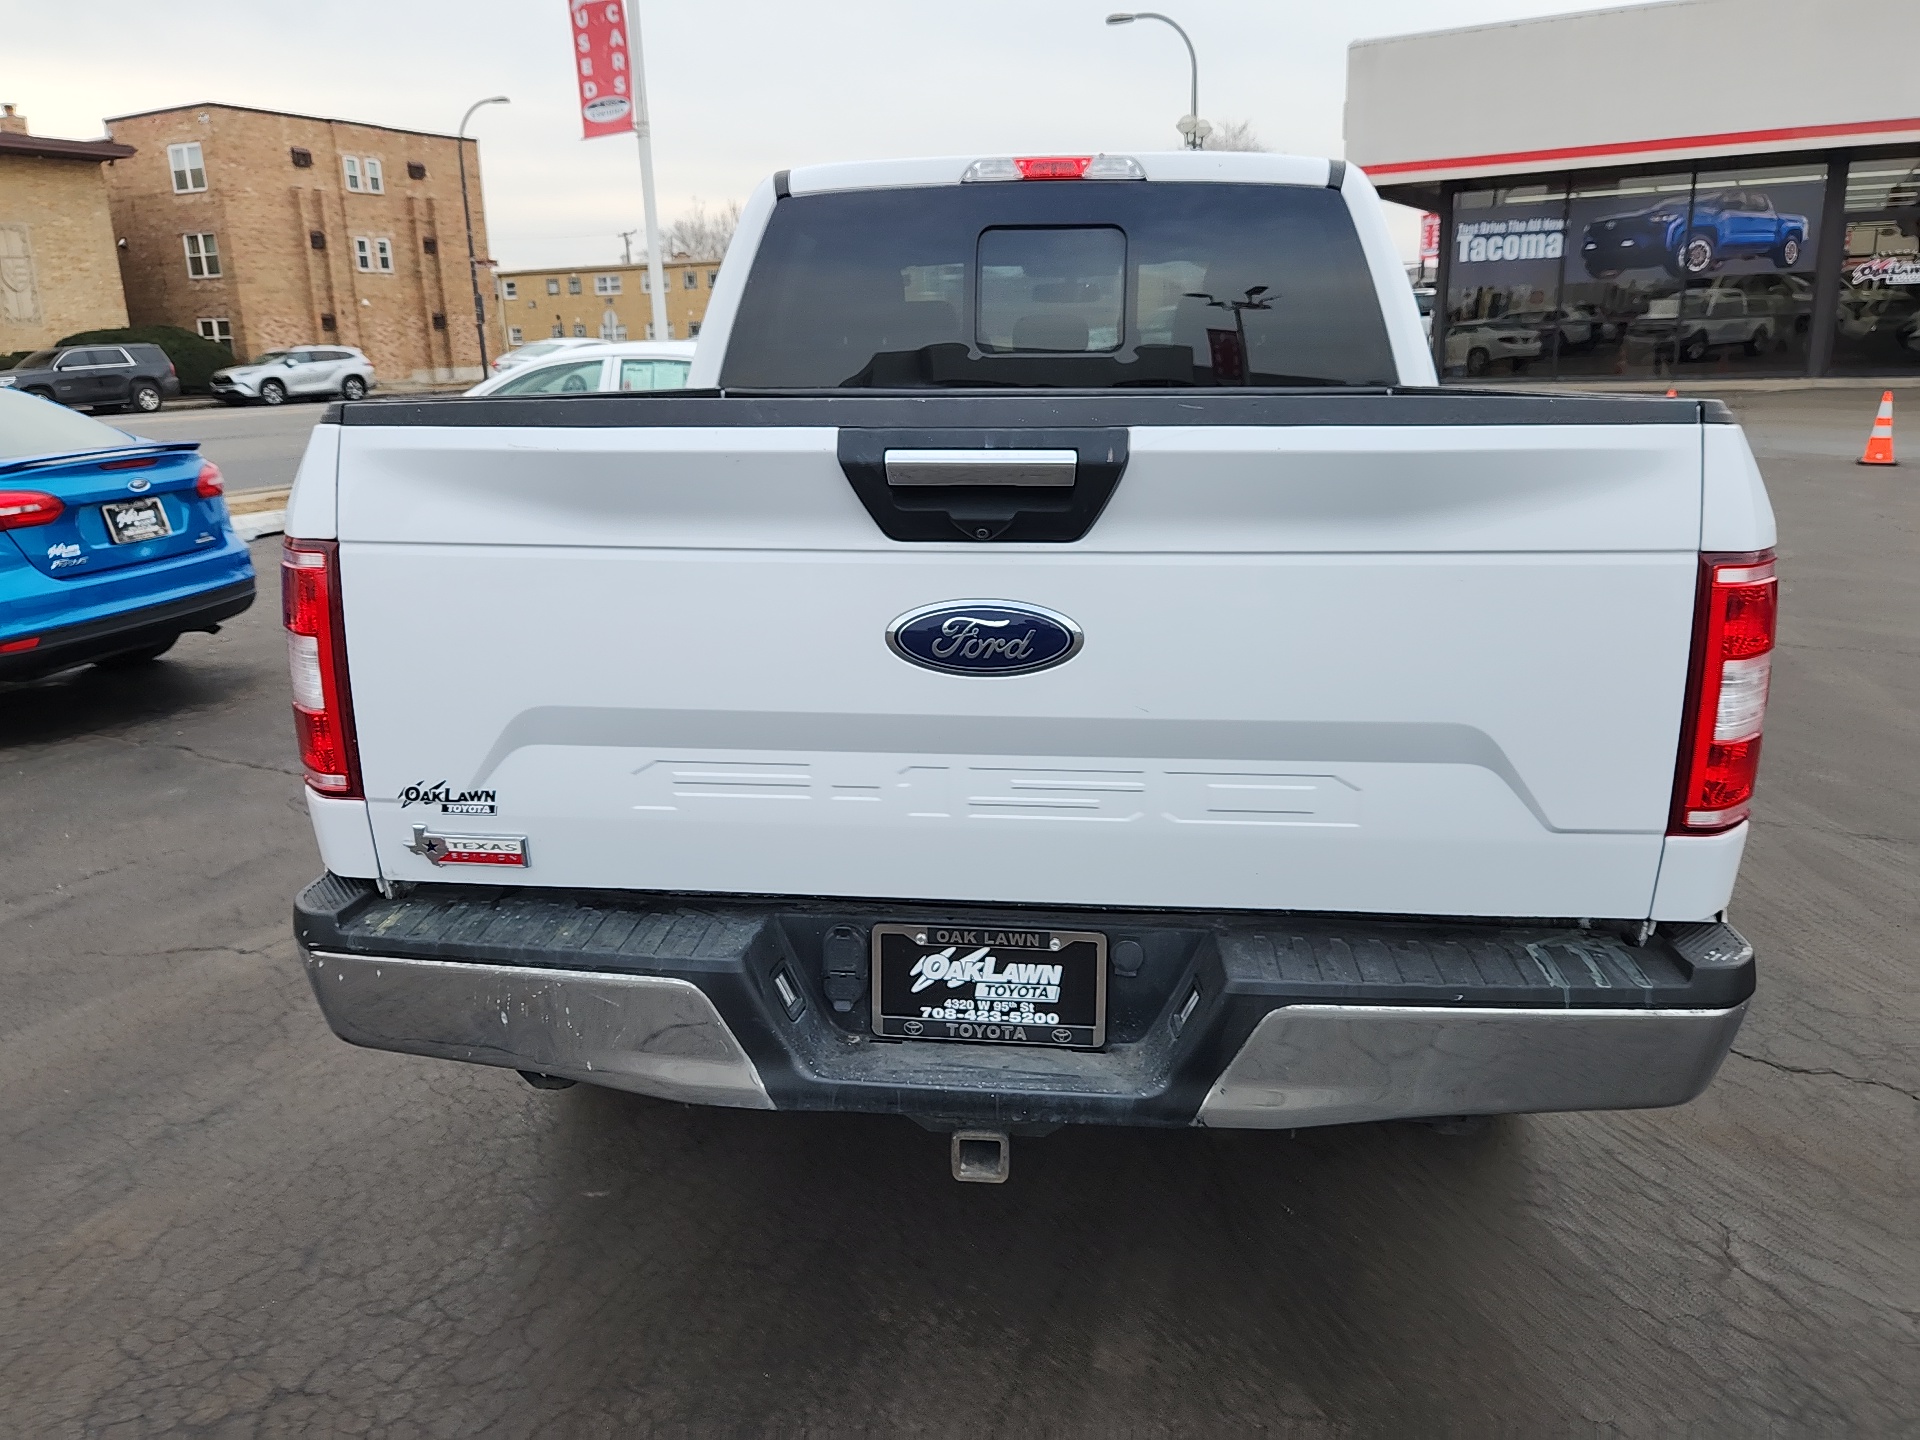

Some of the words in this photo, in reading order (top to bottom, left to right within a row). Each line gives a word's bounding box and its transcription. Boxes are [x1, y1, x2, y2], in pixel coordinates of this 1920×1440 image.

[573, 8, 598, 99] USED
[605, 3, 626, 94] CARS
[1456, 232, 1564, 262] Tacoma
[931, 616, 1036, 660] Ford
[446, 803, 491, 814] TOYOTA
[448, 842, 518, 852] TEXAS
[936, 930, 977, 945] OAK
[984, 931, 1040, 947] LAWN
[984, 984, 1049, 998] TOYOTA
[919, 1006, 1060, 1025] 708-423-5200
[943, 999, 975, 1009] 4320
[976, 1000, 991, 1010] W
[993, 1001, 1018, 1012] 95th
[1019, 1002, 1035, 1013] St
[945, 1022, 1028, 1041] TOYOTA
